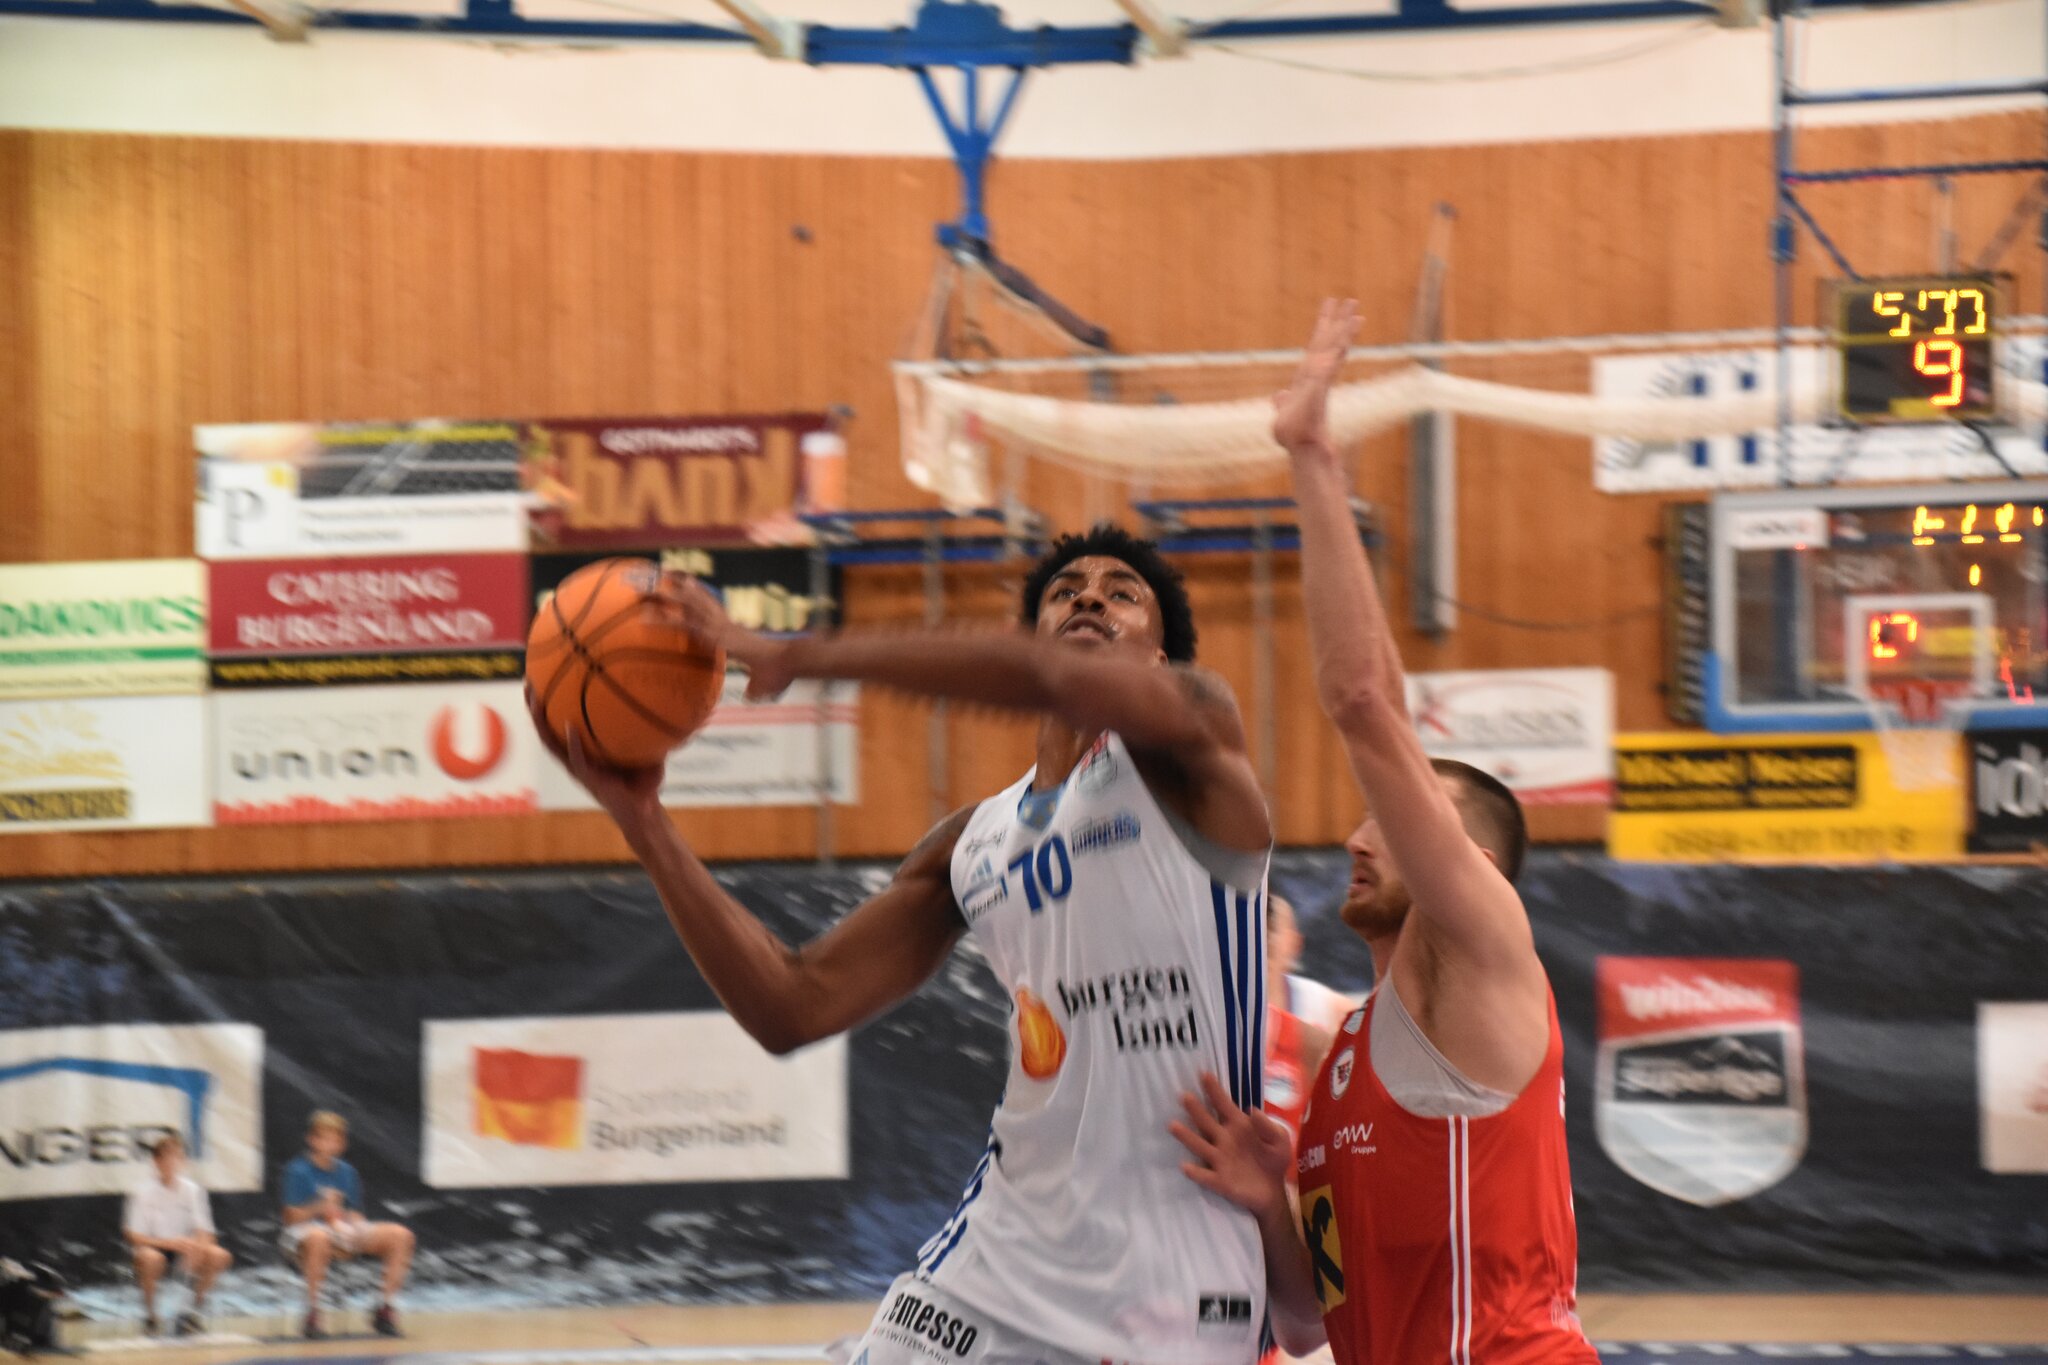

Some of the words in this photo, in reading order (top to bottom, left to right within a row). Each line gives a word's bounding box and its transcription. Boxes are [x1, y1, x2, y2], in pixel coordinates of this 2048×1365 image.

[1913, 339, 1964, 408] 9
[267, 568, 459, 606] CATERING
[237, 609, 494, 648] BURGENLAND
[231, 748, 418, 781] union
[1008, 833, 1072, 912] 10
[1057, 967, 1190, 1019] burgen
[1113, 1005, 1198, 1050] land
[592, 1114, 787, 1157] Burgenland
[1351, 1145, 1377, 1155] Gruppe
